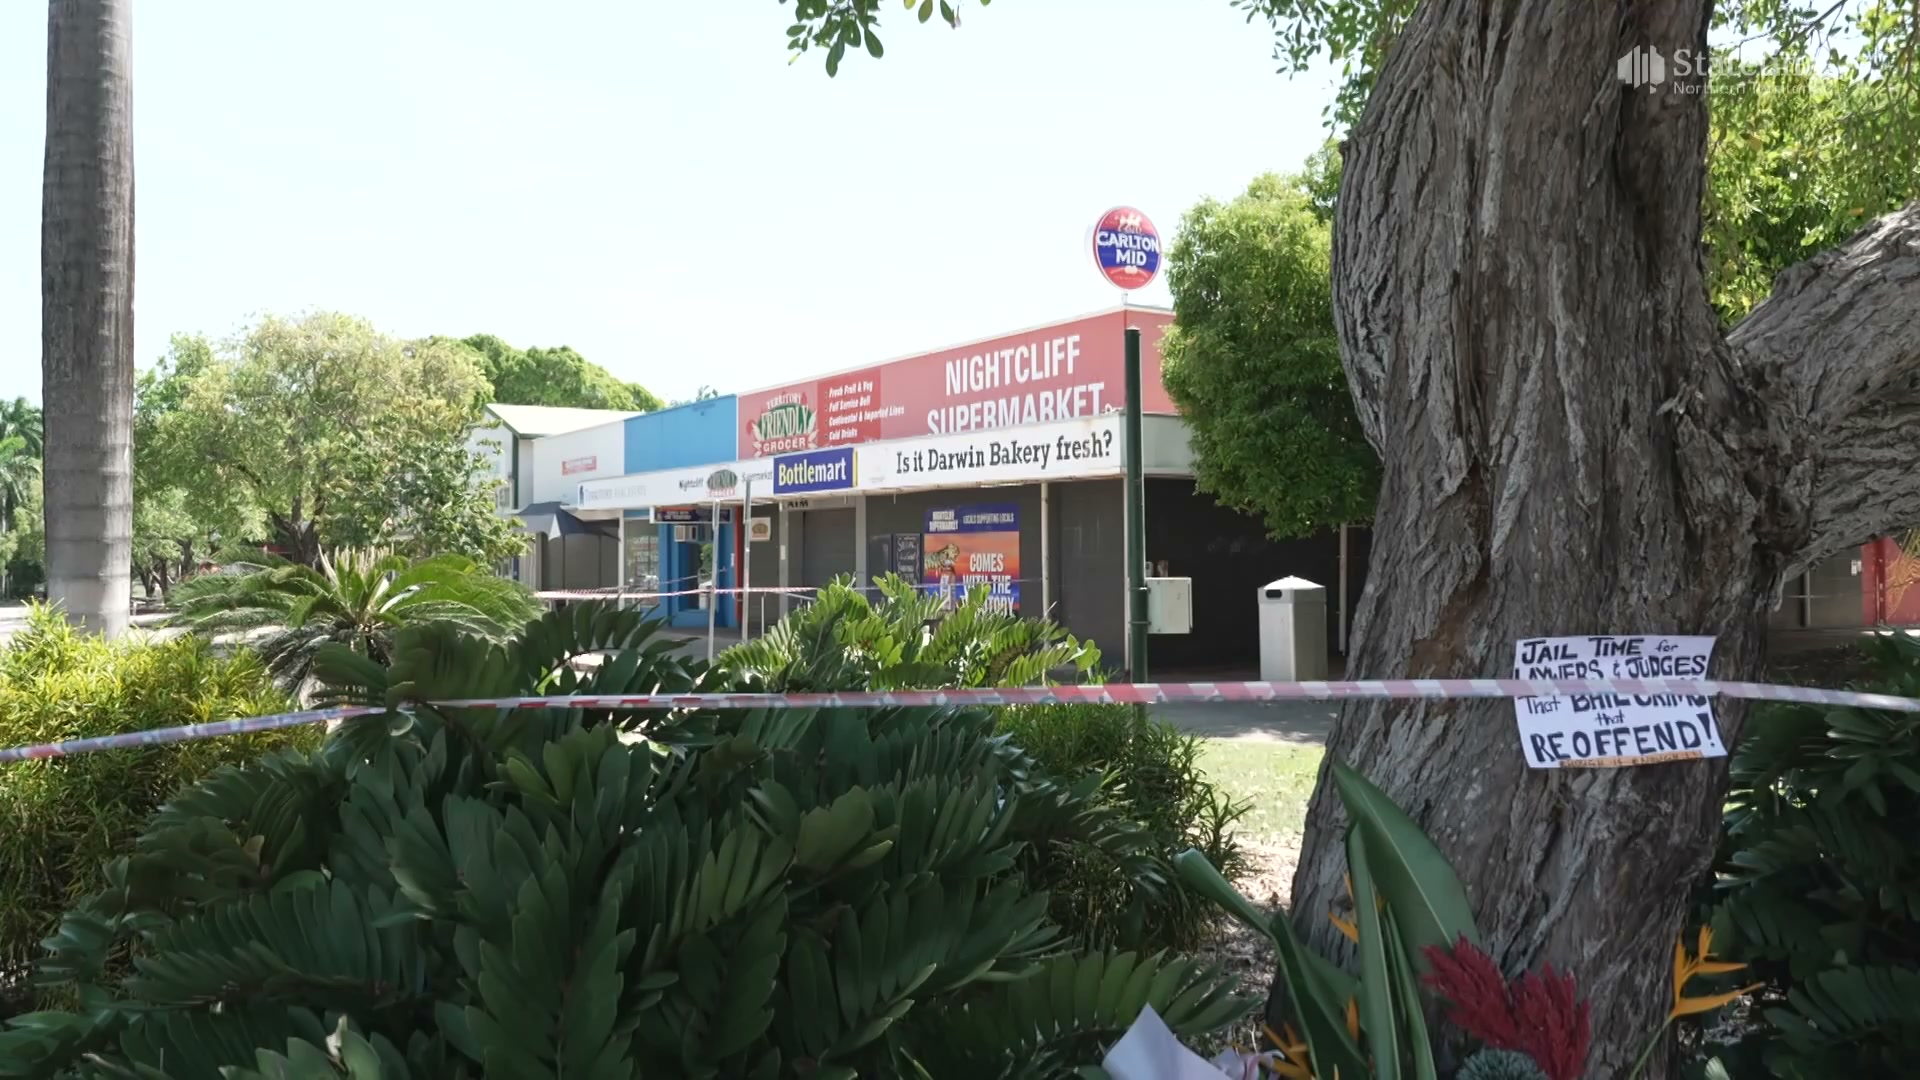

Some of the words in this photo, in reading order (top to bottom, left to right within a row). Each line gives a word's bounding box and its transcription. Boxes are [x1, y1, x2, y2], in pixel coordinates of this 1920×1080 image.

[1098, 230, 1159, 254] CARLTON
[1115, 248, 1147, 266] MID
[945, 334, 1080, 396] NIGHTCLIFF
[829, 387, 843, 398] Fresh
[863, 381, 873, 392] Veg
[766, 393, 802, 410] TERRITORY
[927, 381, 1104, 436] SUPERMARKET
[760, 404, 810, 441] FRIENDLY
[763, 437, 806, 452] GROCER
[829, 430, 840, 441] Cold
[841, 427, 858, 439] Drinks
[896, 451, 910, 474] Is
[913, 450, 924, 472] it
[928, 444, 985, 471] Darwin
[989, 440, 1051, 470] Bakery
[1056, 429, 1113, 460] fresh?
[778, 457, 847, 486] Bottlemart
[969, 553, 1004, 573] COMES
[992, 575, 1012, 594] THE
[959, 595, 1015, 617] TITORY
[1522, 639, 1578, 665] JAIL
[1588, 637, 1644, 657] TIME
[1655, 639, 1679, 653] for
[1625, 655, 1707, 679] JUDGES
[1518, 694, 1561, 715] That
[1595, 709, 1625, 726] that
